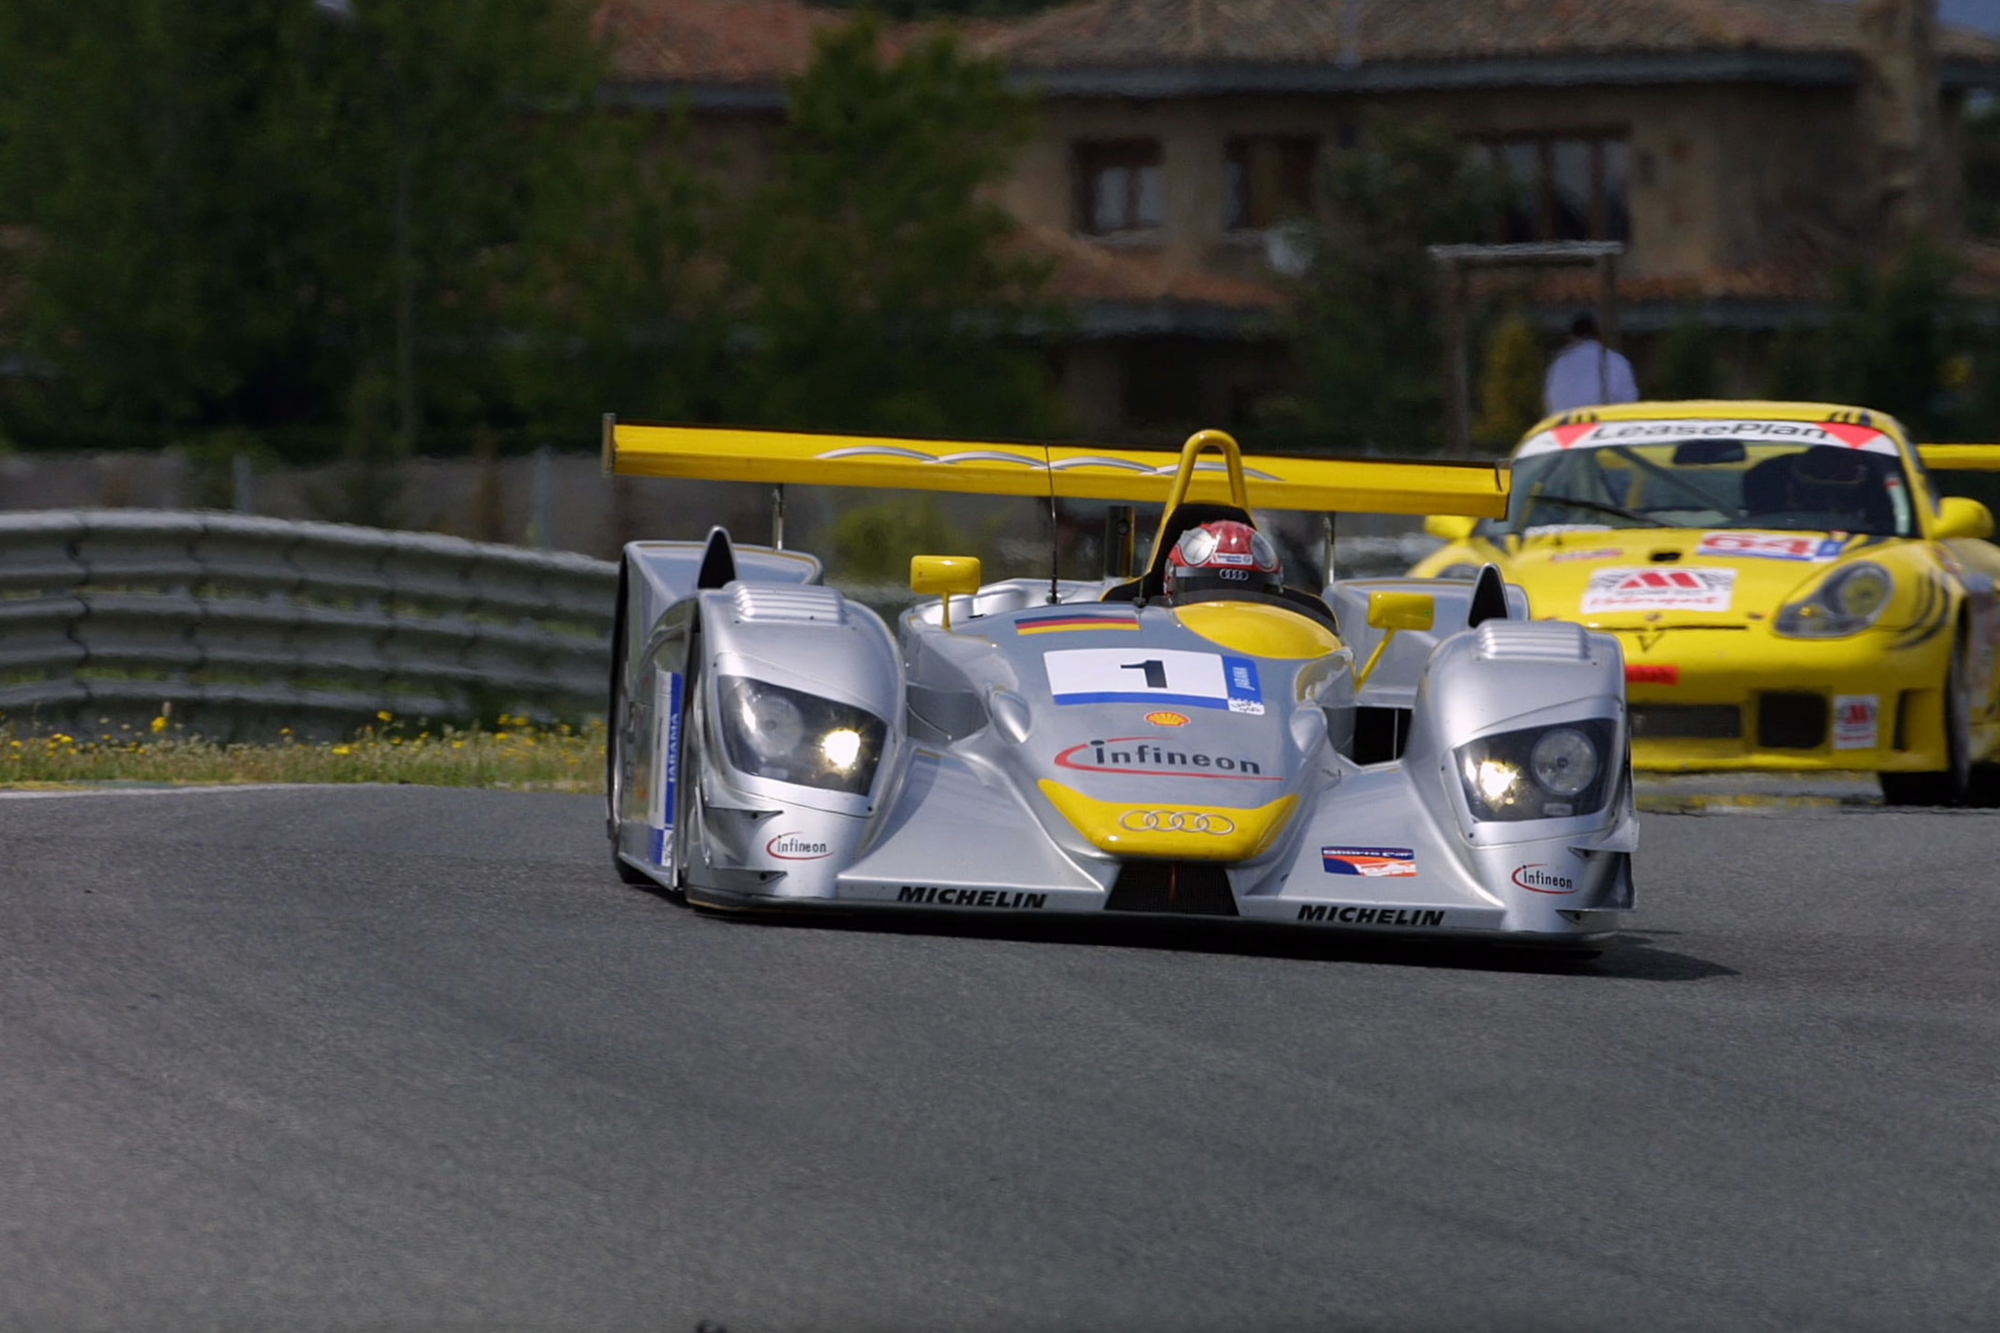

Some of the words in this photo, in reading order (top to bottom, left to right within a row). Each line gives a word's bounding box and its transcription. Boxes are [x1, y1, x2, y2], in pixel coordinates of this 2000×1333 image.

[1591, 423, 1827, 439] LeasePlan
[1702, 535, 1811, 555] 64
[1120, 660, 1168, 688] 1
[1090, 740, 1261, 774] infineon
[898, 886, 1049, 908] MICHELIN
[1298, 904, 1446, 926] MICHELIN
